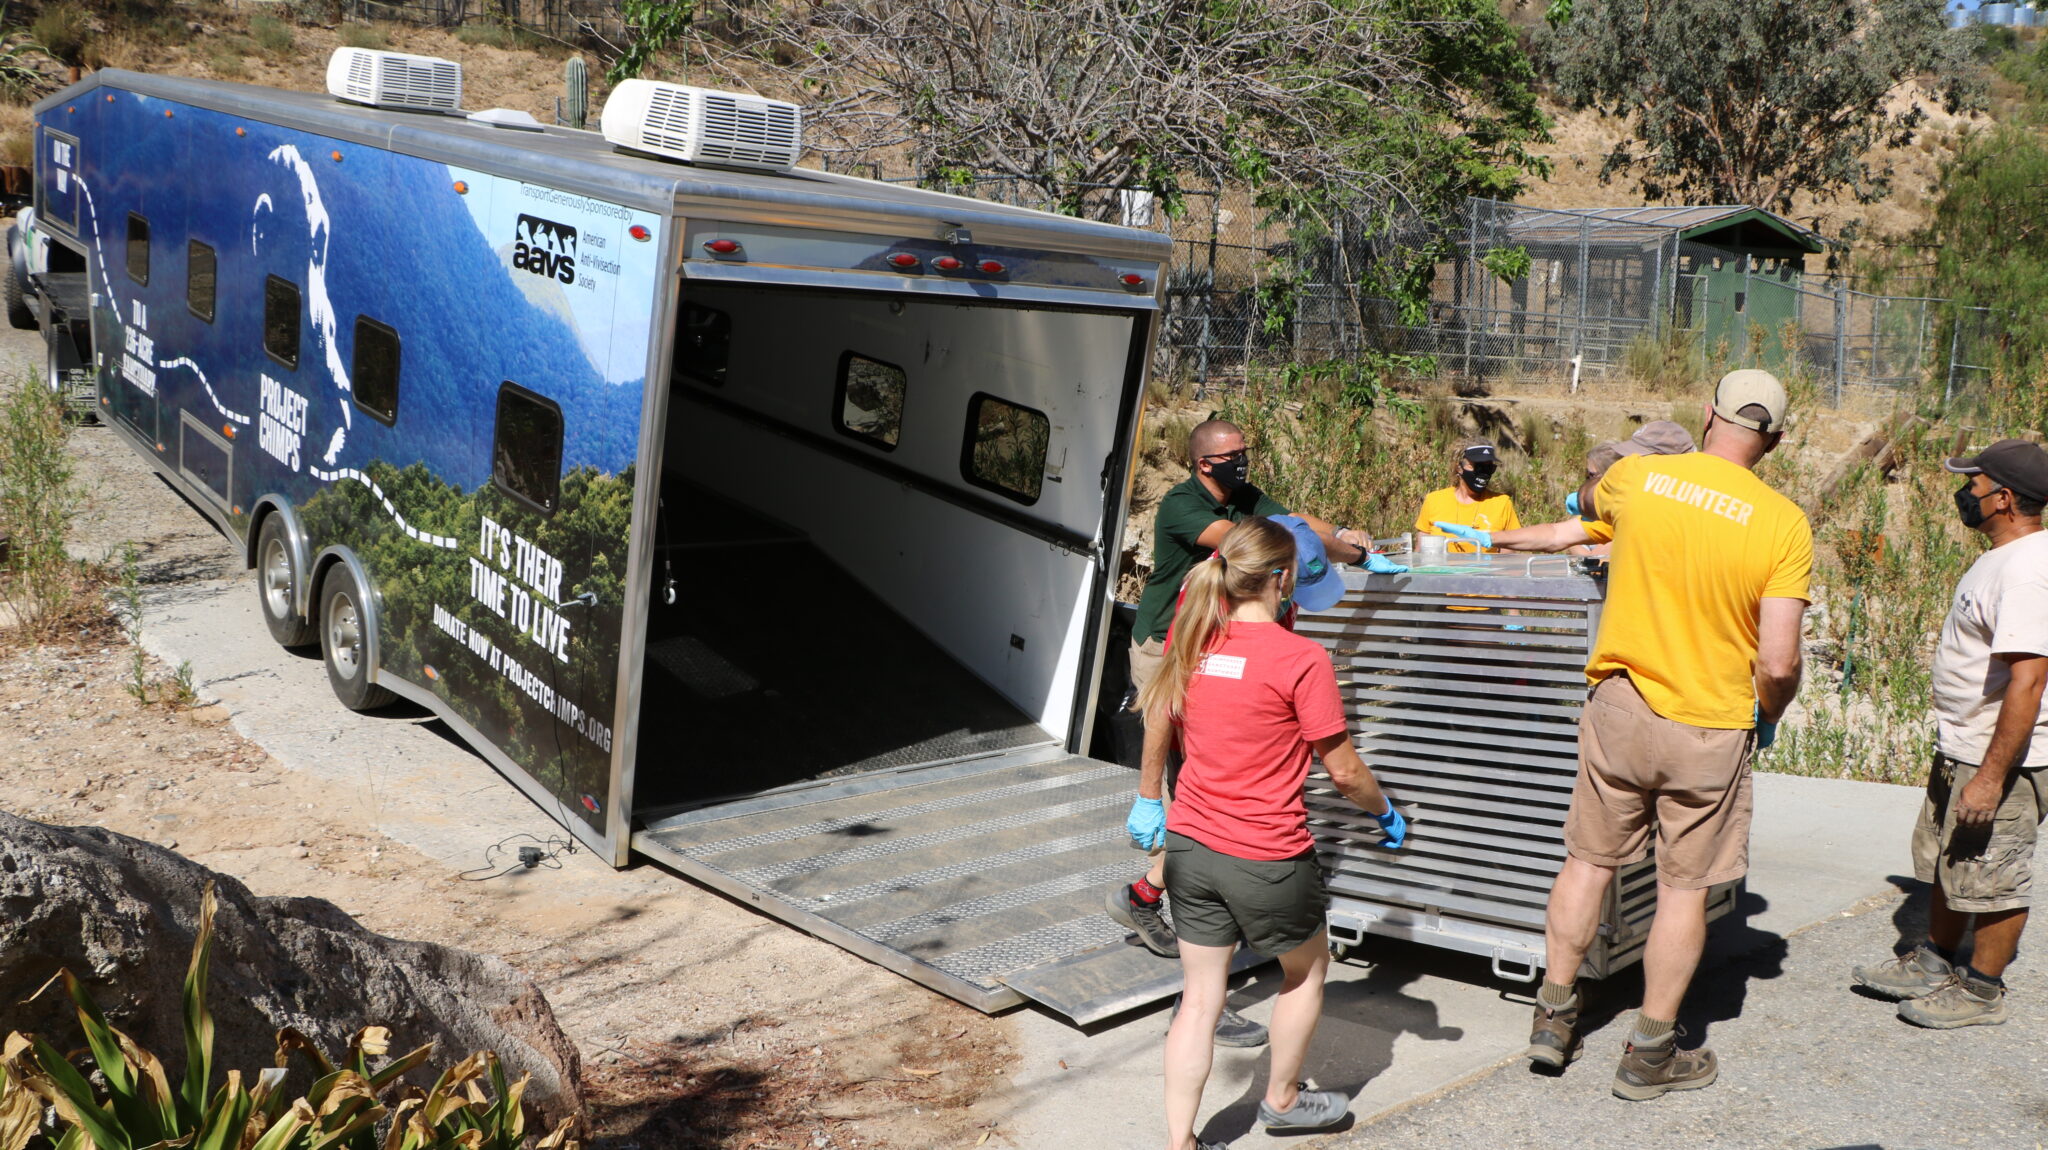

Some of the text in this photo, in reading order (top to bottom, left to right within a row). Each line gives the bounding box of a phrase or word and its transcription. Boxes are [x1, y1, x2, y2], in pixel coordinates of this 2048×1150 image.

[513, 241, 575, 285] aavs
[580, 251, 621, 276] Anti-Vivisection
[583, 230, 607, 249] American
[578, 272, 597, 293] Society
[260, 373, 308, 437] PROJECT
[259, 412, 301, 473] CHIMPS
[1643, 471, 1754, 527] VOLUNTEER
[480, 515, 563, 606] IT'S THEIR
[469, 556, 571, 664] TIME TO LIVE
[433, 603, 611, 754] DONATE NOW AT PROJECTCHIMPS.ORG
